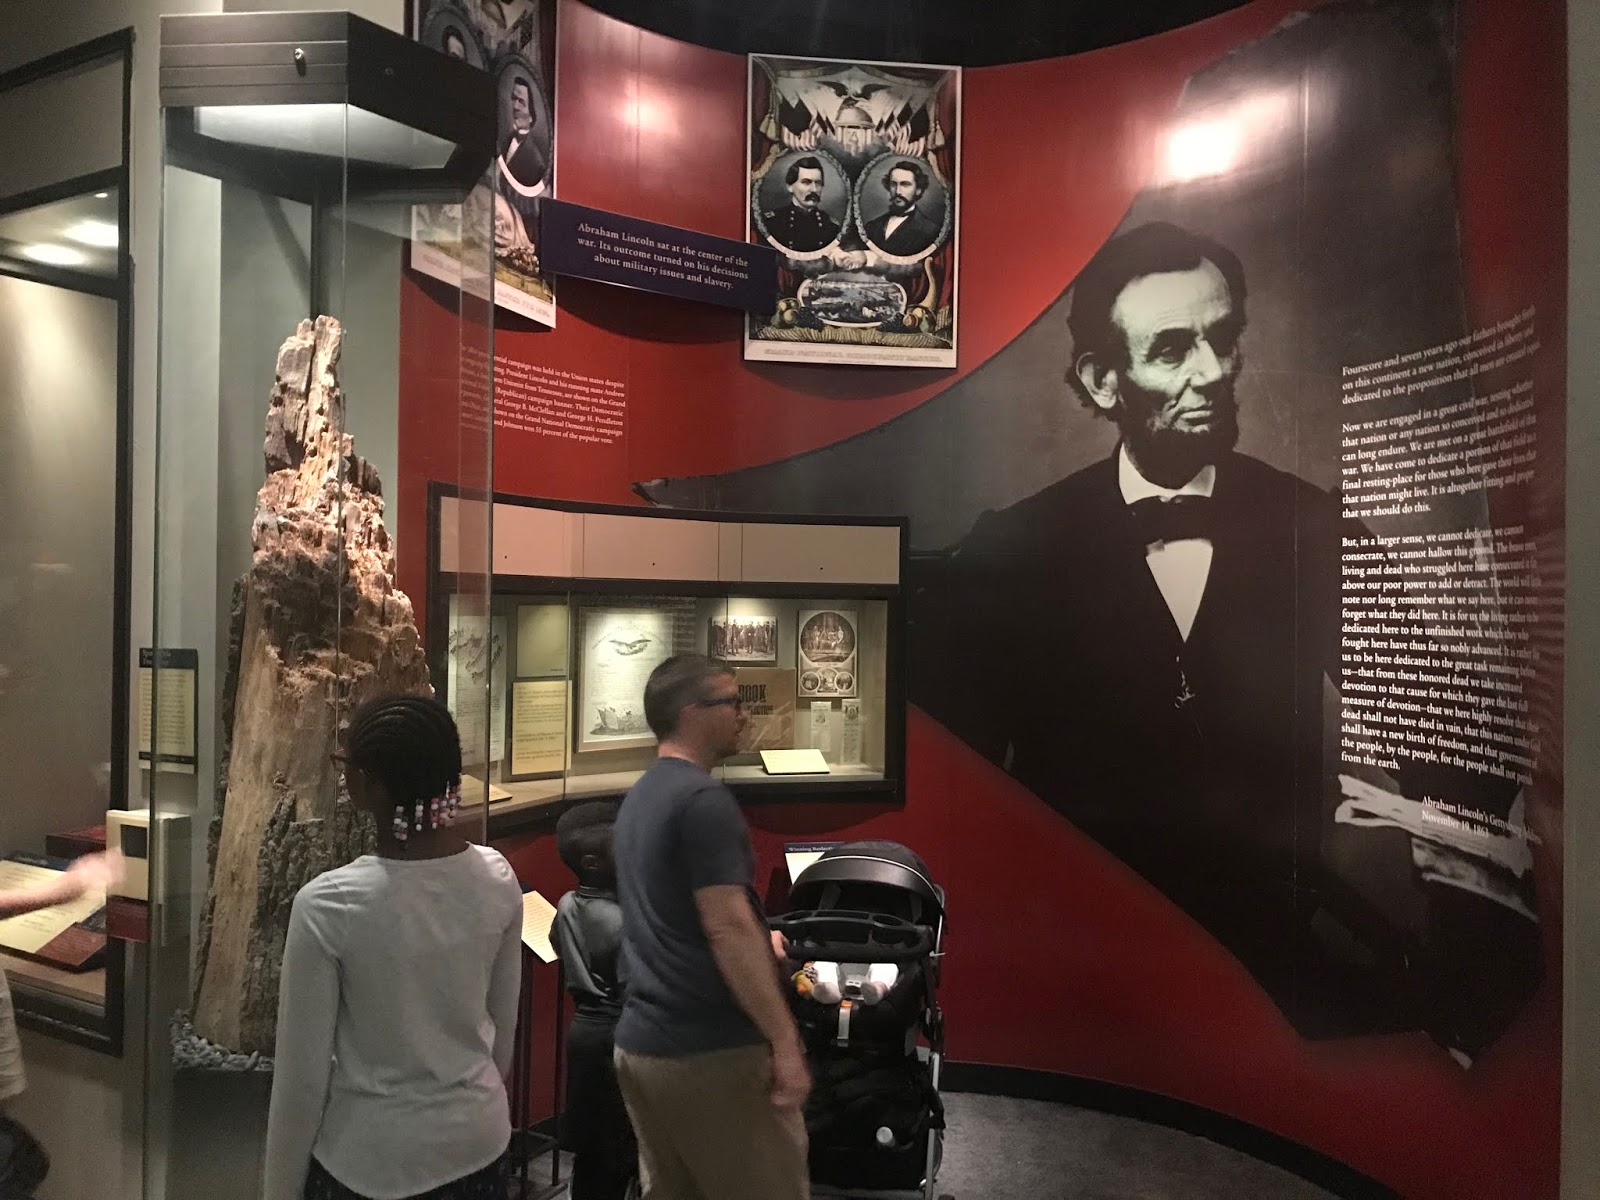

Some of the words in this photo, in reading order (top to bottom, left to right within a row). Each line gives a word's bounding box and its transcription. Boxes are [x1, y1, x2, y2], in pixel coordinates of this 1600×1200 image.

[578, 223, 619, 239] Abraham
[622, 232, 655, 246] Lincoln
[657, 242, 669, 250] sat
[671, 244, 680, 252] at
[682, 245, 696, 255] the
[697, 251, 723, 261] center
[724, 255, 734, 263] of
[735, 256, 748, 266] the
[578, 239, 597, 248] war.
[599, 240, 611, 250] Its
[613, 246, 651, 259] outcome
[653, 253, 682, 266] turned
[697, 261, 709, 272] his
[711, 264, 748, 279] decisions
[594, 254, 620, 266] about
[622, 260, 658, 275] military
[659, 266, 684, 279] issues
[686, 274, 702, 283] and
[704, 276, 734, 291] slavery.
[1342, 362, 1382, 376] Fourscore
[1384, 355, 1400, 368] and
[506, 368, 528, 379] President
[529, 372, 548, 384] Lincoln
[549, 378, 559, 386] and
[559, 379, 567, 387] his
[604, 387, 625, 397] Andrew
[543, 365, 554, 375] held
[561, 370, 570, 378] the
[605, 377, 624, 389] despite
[1372, 368, 1411, 385] continent
[524, 382, 537, 391] from
[599, 396, 608, 404] the
[609, 398, 626, 407] Grand
[1342, 388, 1381, 405] dedicated
[1392, 384, 1406, 395] the
[527, 395, 553, 407] campaign
[575, 402, 590, 411] Their
[591, 404, 624, 416] Democratic
[528, 404, 555, 416] McClellan
[556, 410, 566, 418] and
[567, 411, 586, 423] George
[587, 414, 594, 422] H.
[595, 415, 623, 426] Pendleton
[524, 413, 541, 423] Grand
[542, 416, 564, 427] National
[565, 420, 596, 432] Democratic
[596, 427, 623, 437] campaign
[1342, 423, 1361, 433] Now
[1363, 422, 1373, 431] we
[1375, 421, 1388, 429] are
[1389, 411, 1422, 428] engaged
[562, 430, 569, 438] of
[569, 431, 578, 439] the
[578, 434, 600, 443] popular
[1342, 437, 1358, 447] that
[1360, 434, 1387, 446] nation
[1415, 425, 1440, 436] nation
[1342, 453, 1356, 462] can
[1358, 450, 1377, 461] long
[1360, 464, 1373, 474] We
[1375, 462, 1394, 473] have
[1394, 460, 1416, 471] come
[1342, 479, 1361, 490] final
[1414, 472, 1426, 482] for
[1427, 469, 1448, 480] those
[1342, 494, 1359, 504] that
[1360, 492, 1387, 503] nation
[1388, 488, 1412, 502] might
[1342, 508, 1359, 518] that
[1360, 509, 1371, 517] we
[1372, 504, 1400, 516] should
[1414, 502, 1431, 513] this.
[1342, 537, 1359, 548] But,
[1360, 536, 1369, 546] in
[1377, 535, 1400, 548] larger
[1401, 536, 1425, 544] sense,
[1342, 551, 1386, 561] consecrate,
[1399, 549, 1427, 559] cannot
[1342, 565, 1365, 578] living
[1366, 565, 1382, 575] and
[1383, 564, 1402, 575] dead
[1403, 563, 1421, 574] who
[1342, 579, 1365, 590] above
[1382, 582, 1401, 592] poor
[1403, 581, 1427, 592] power
[1342, 595, 1360, 604] note
[1362, 596, 1376, 604] nor
[1378, 594, 1396, 607] long
[1397, 594, 1436, 604] remember
[1342, 608, 1366, 622] forget
[1367, 608, 1388, 619] what
[1389, 609, 1406, 623] they
[1407, 609, 1420, 620] did
[1342, 622, 1380, 633] dedicated
[1382, 623, 1399, 634] here
[1411, 625, 1423, 635] the
[1342, 637, 1370, 651] fought
[1371, 638, 1388, 649] here
[1389, 639, 1408, 650] have
[1428, 641, 1439, 652] far
[1342, 654, 1351, 662] us
[1353, 653, 1362, 662] to
[1363, 652, 1373, 663] be
[1375, 653, 1392, 664] here
[1393, 654, 1430, 666] dedicated
[1376, 668, 1396, 679] from
[1397, 669, 1418, 681] these
[1419, 671, 1450, 684] honored
[1342, 680, 1377, 692] devotion
[1378, 684, 1387, 693] to
[1388, 683, 1405, 694] that
[1406, 688, 1428, 698] cause
[1429, 688, 1441, 699] for
[1341, 697, 1375, 707] measure
[1376, 697, 1386, 708] of
[1341, 708, 1361, 720] dead
[1362, 710, 1382, 722] shall
[1383, 715, 1397, 724] not
[1399, 714, 1416, 727] have
[1418, 717, 1435, 729] died
[1341, 722, 1361, 734] shall
[1362, 724, 1381, 737] have
[1388, 731, 1405, 740] new
[1406, 730, 1425, 743] birth
[1437, 736, 1469, 753] freedom,
[1341, 737, 1355, 748] the
[1356, 741, 1385, 754] people,
[1386, 743, 1396, 758] by
[1397, 745, 1410, 756] the
[1411, 749, 1440, 763] people,
[1440, 751, 1452, 763] for
[1341, 751, 1361, 763] from
[1363, 754, 1376, 765] the
[1377, 759, 1401, 770] earth.
[1421, 796, 1456, 814] Abraham
[1458, 806, 1488, 823] Lincoln's
[1421, 811, 1460, 829] November
[1461, 821, 1471, 833] 19,
